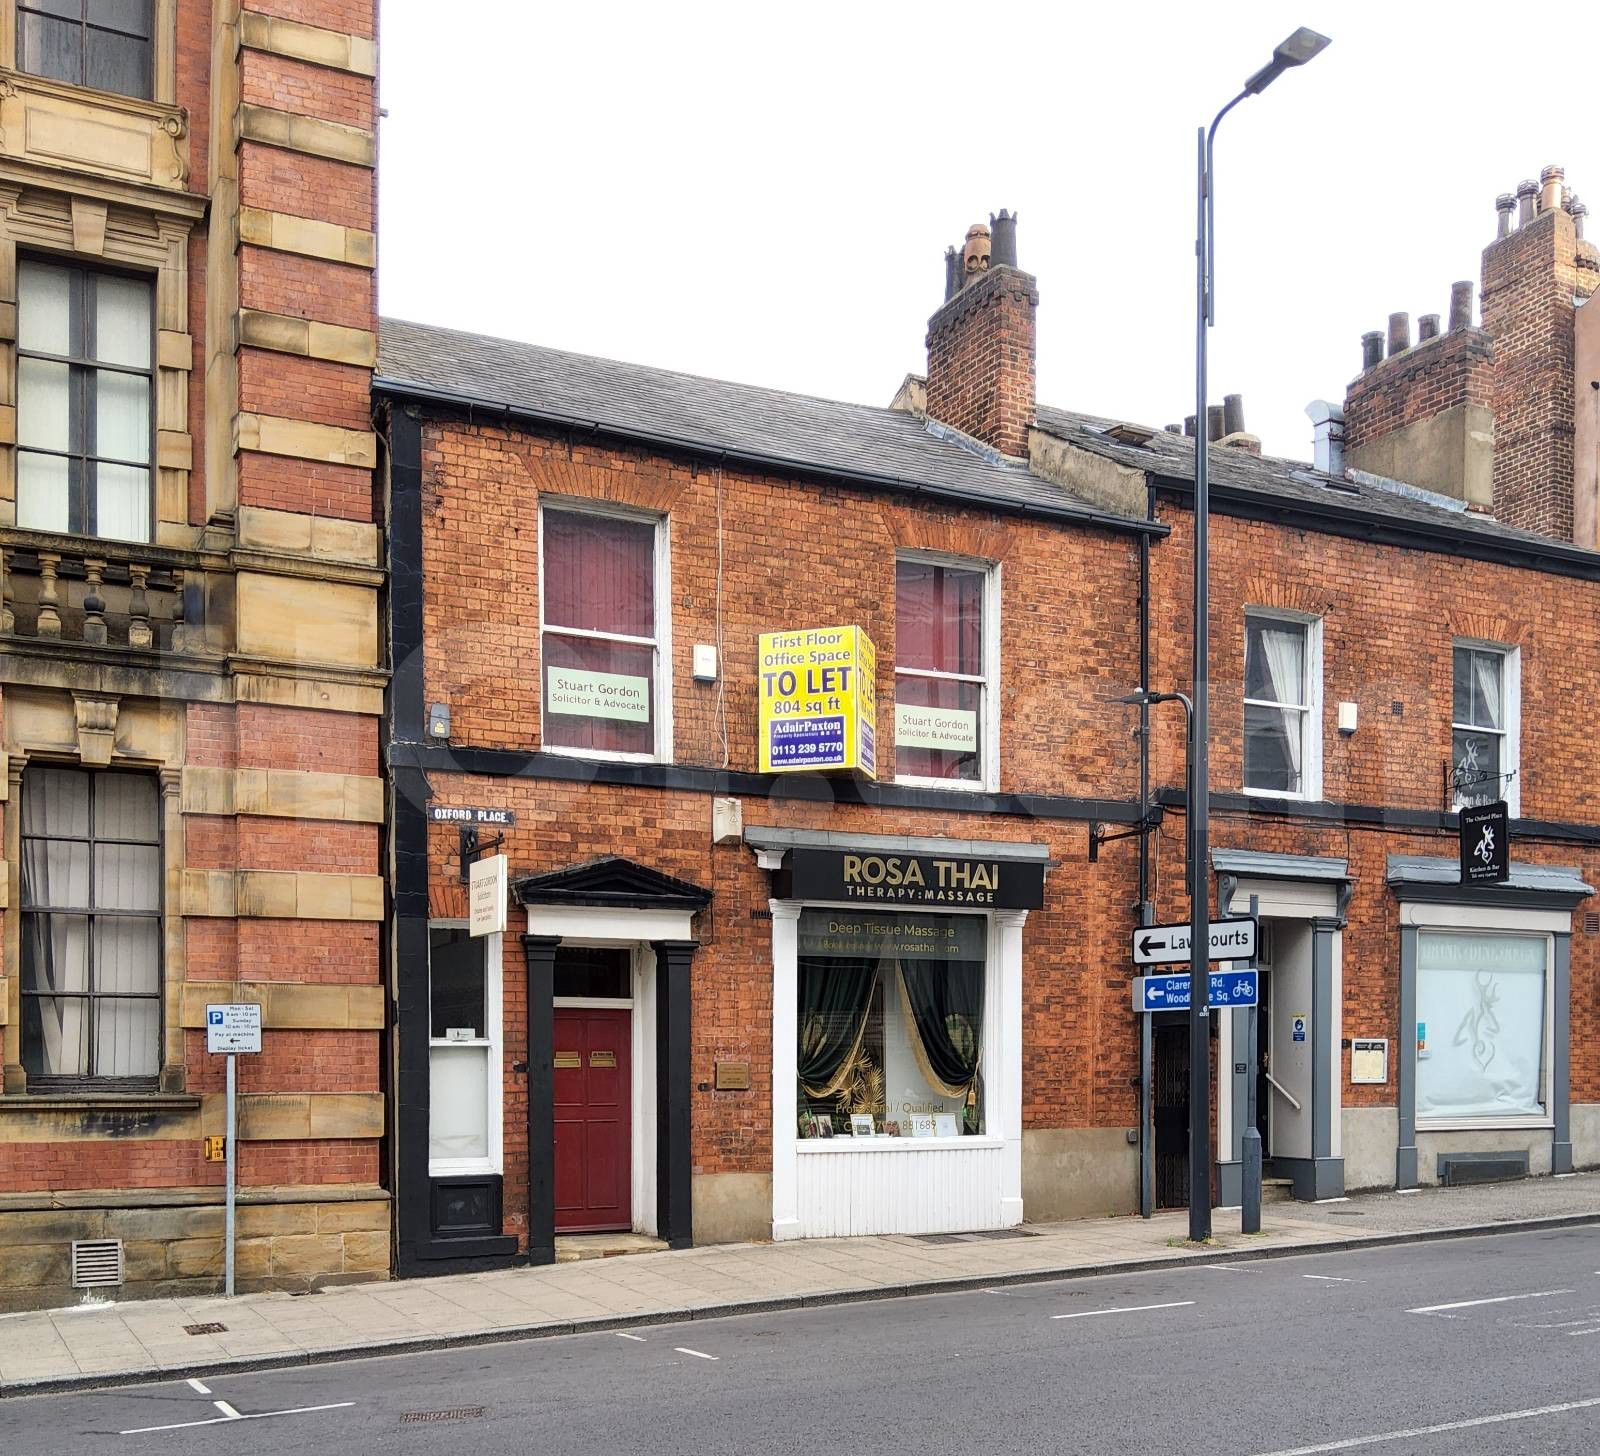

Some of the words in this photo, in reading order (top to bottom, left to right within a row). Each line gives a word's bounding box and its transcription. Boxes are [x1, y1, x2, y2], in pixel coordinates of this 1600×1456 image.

[772, 637, 800, 648] First
[807, 633, 842, 645] Floor
[764, 654, 804, 666] Office
[810, 651, 850, 665] Space
[557, 678, 594, 693] Stuart
[597, 684, 640, 698] Gordon
[763, 670, 796, 697] TO
[807, 667, 852, 693] LET
[552, 694, 590, 706] Solicitor
[594, 698, 601, 706] &
[604, 700, 646, 712] Advocate
[774, 701, 800, 714] 804
[806, 702, 822, 714] sq
[827, 697, 840, 710] ft
[774, 721, 840, 734] AdairPaxton
[902, 713, 931, 726] Stuart
[933, 716, 969, 730] Gordon
[898, 726, 929, 738] Solicitor
[932, 730, 938, 738] &
[940, 731, 973, 743] Advocate
[772, 745, 795, 755] 0113
[798, 744, 816, 753] 239
[819, 742, 843, 752] 5770
[773, 755, 842, 765] www.adairpaxton.co.uk
[435, 809, 472, 820] OXFORD
[844, 855, 925, 886] ROSA
[933, 861, 998, 890] THAI
[829, 922, 861, 936] Deep
[864, 923, 900, 934] Tissue
[904, 925, 955, 938] Massae
[1208, 930, 1248, 946] ourts
[902, 1102, 944, 1113] Qualified
